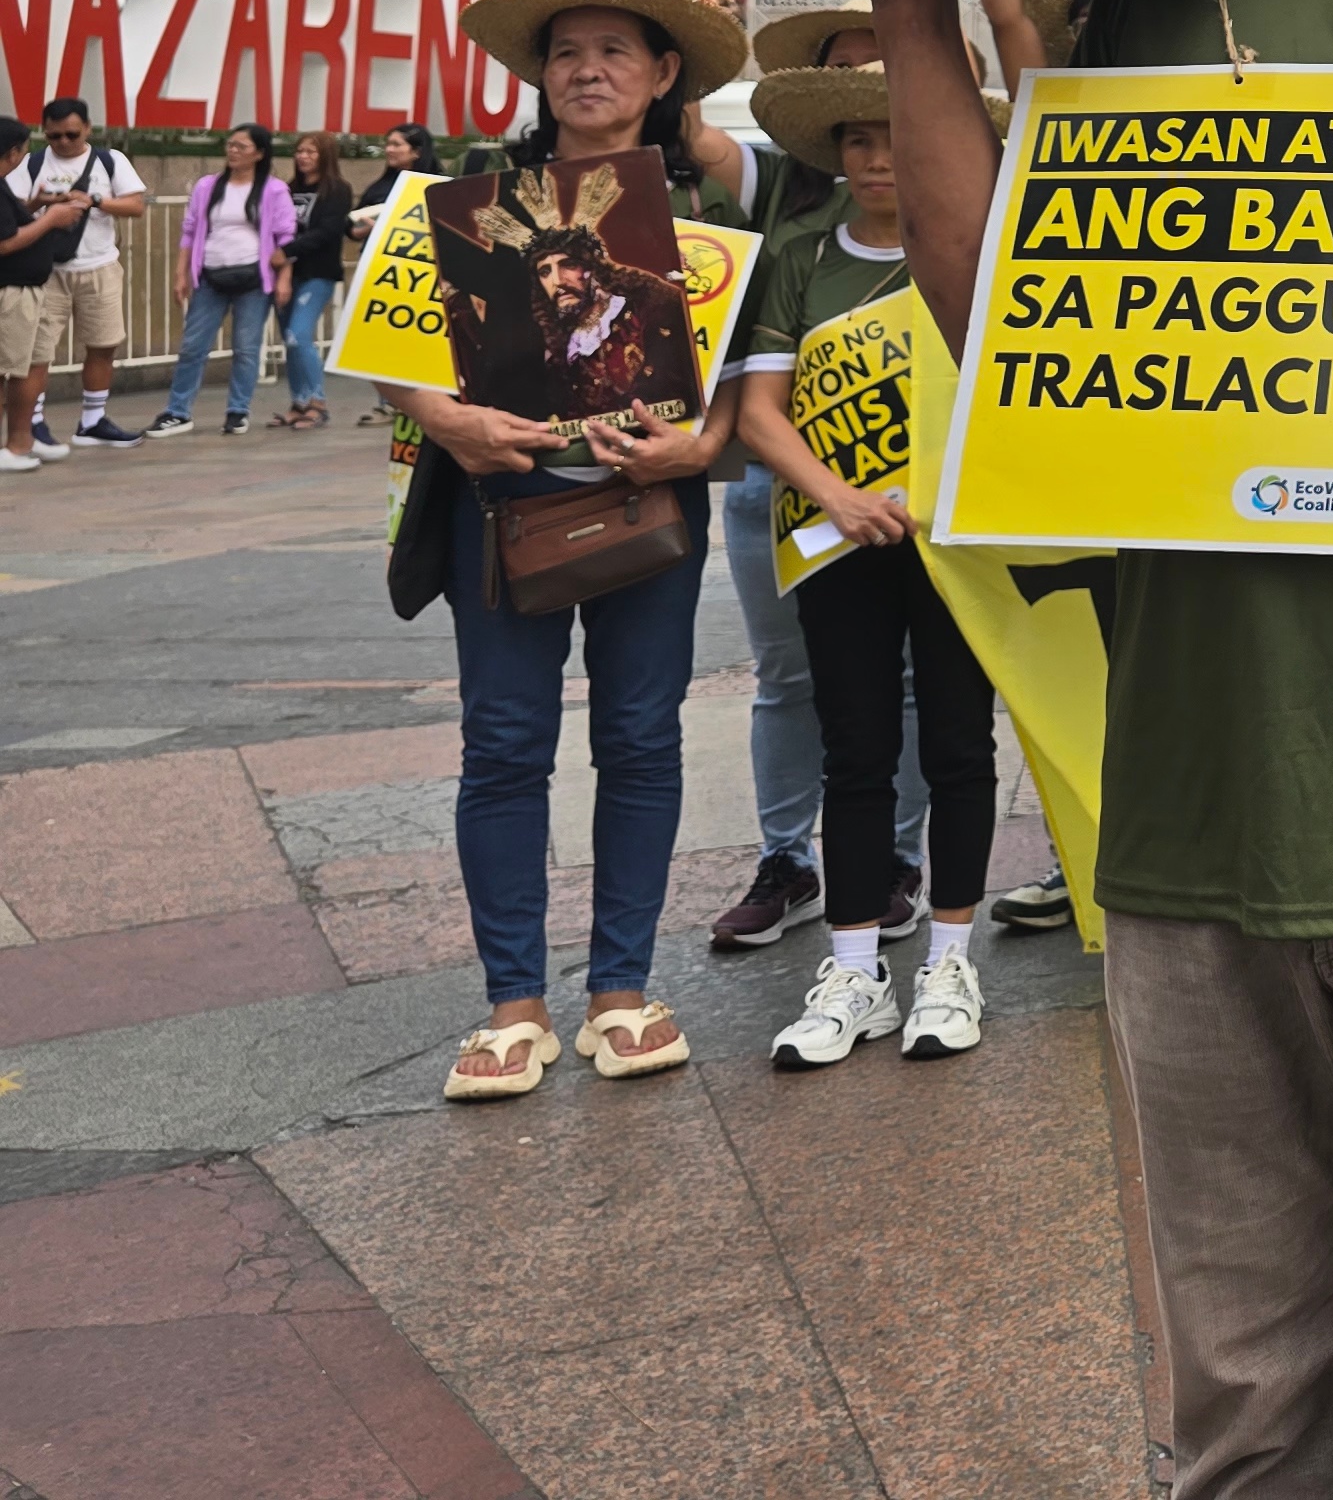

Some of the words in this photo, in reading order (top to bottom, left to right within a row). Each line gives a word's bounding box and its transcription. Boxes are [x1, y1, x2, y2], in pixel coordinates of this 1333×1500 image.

[1038, 116, 1270, 165] IWASAN
[1023, 187, 1207, 252] ANG
[374, 263, 429, 294] AY
[363, 298, 448, 338] POO
[1003, 274, 1094, 330] SA
[843, 319, 885, 351] NG
